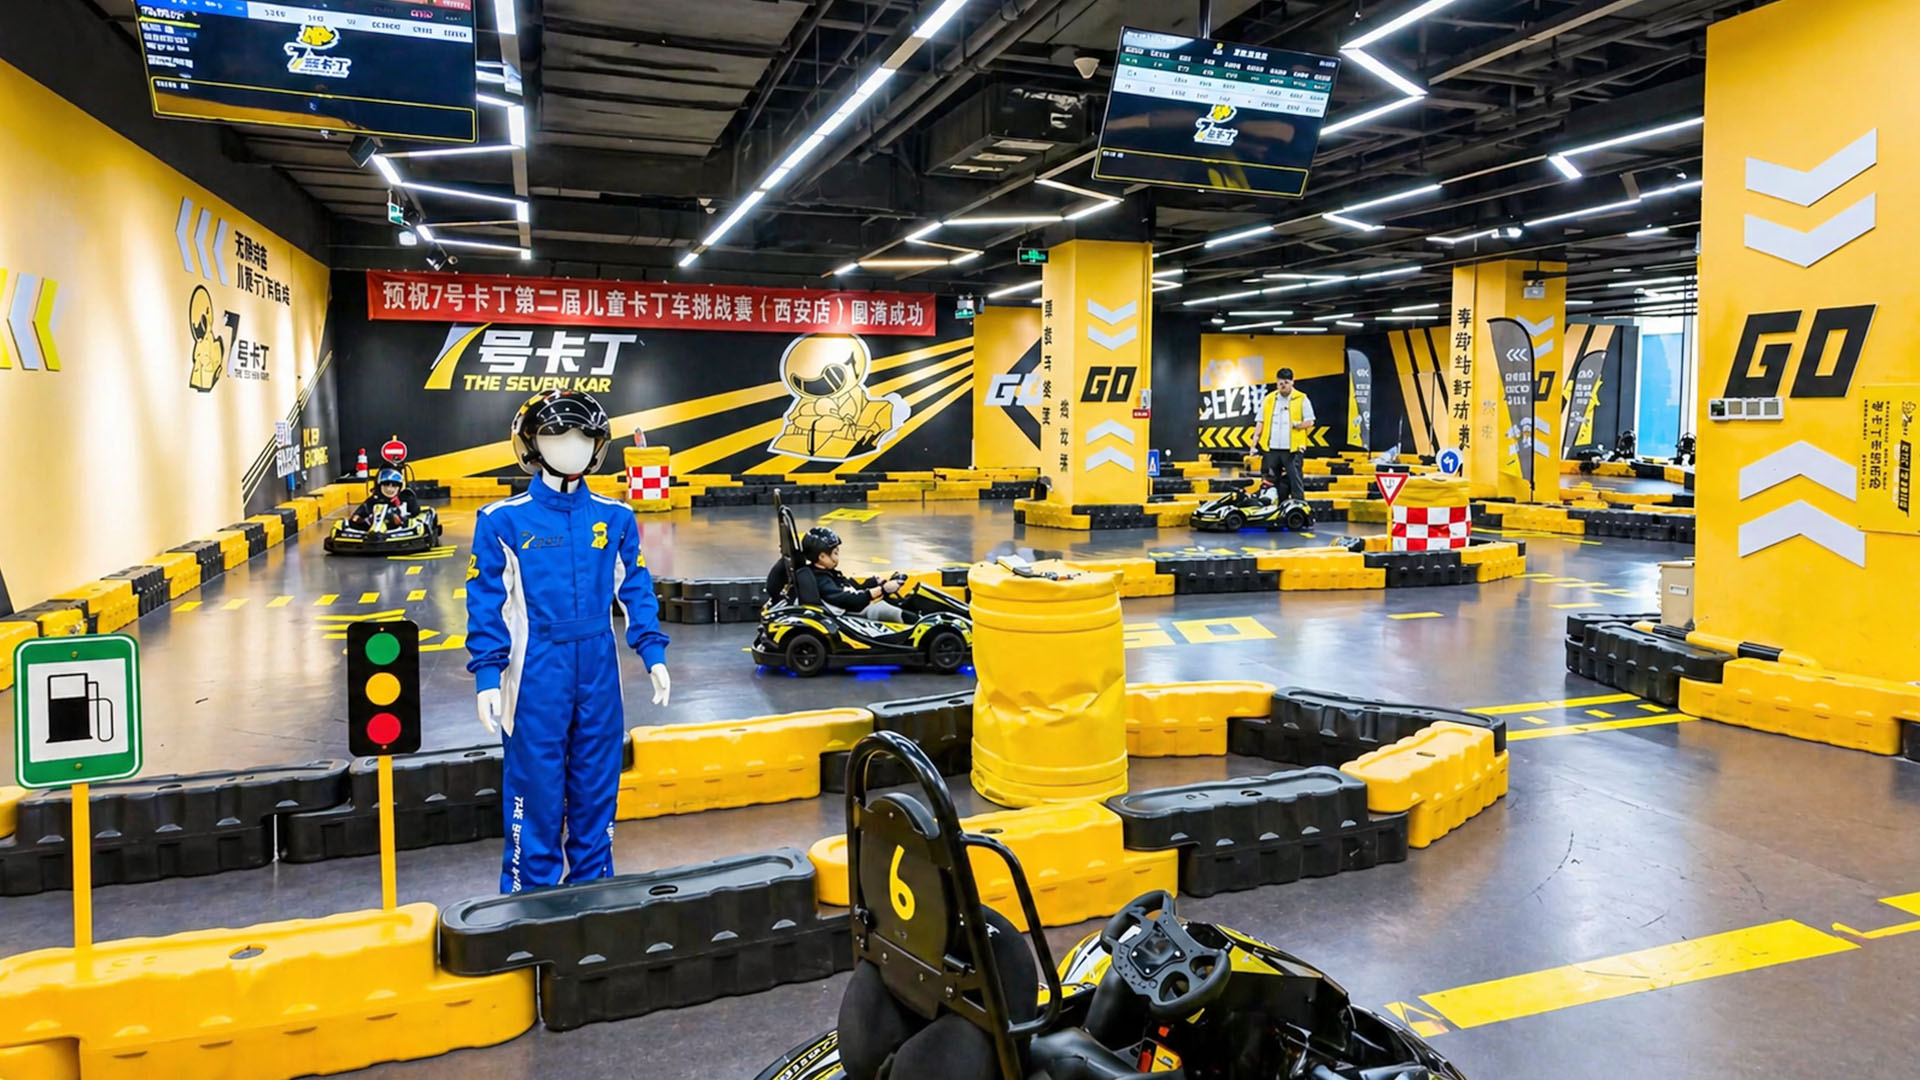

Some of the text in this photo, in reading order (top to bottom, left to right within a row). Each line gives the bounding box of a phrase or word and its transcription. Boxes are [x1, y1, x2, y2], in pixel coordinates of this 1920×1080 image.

[1723, 304, 1878, 398] GO
[464, 374, 501, 391] THE
[1080, 366, 1138, 403] GO
[888, 844, 916, 921] 6
